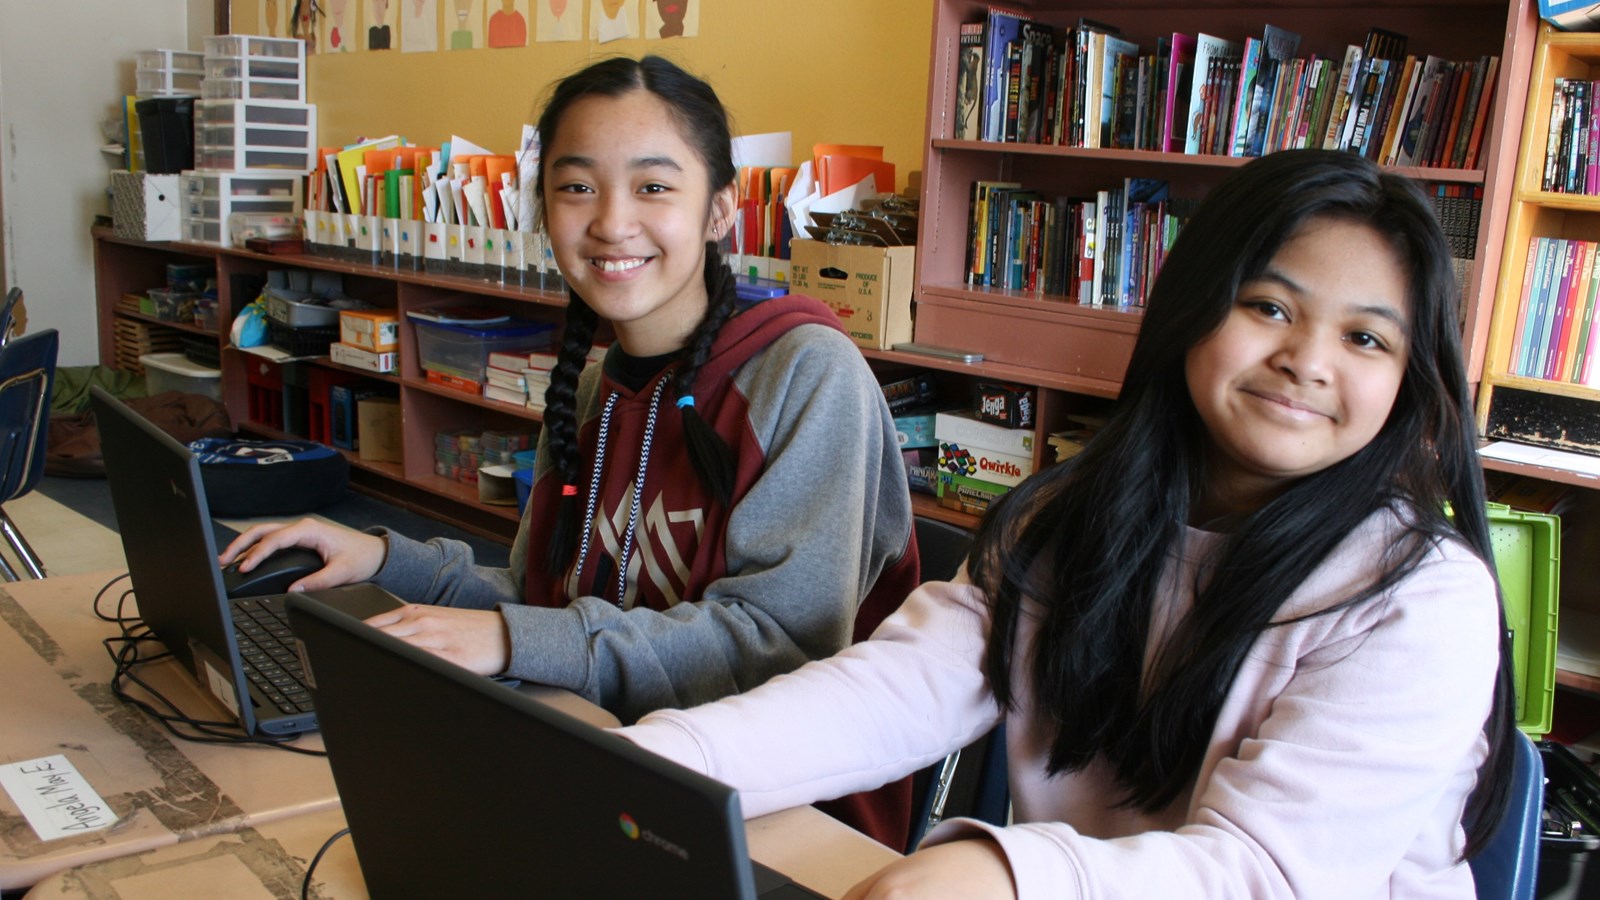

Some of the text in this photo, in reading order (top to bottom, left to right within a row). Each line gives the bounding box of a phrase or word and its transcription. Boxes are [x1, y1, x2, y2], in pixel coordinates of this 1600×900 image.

[1351, 108, 1369, 148] POINT BLANK
[856, 273, 877, 281] PRODUCE
[981, 396, 1005, 416] Jenga
[1019, 397, 1032, 426] Jenga
[979, 457, 1021, 477] Qwirkle
[36, 772, 74, 796] May
[46, 794, 107, 831] Angela
[641, 829, 689, 861] chrome
